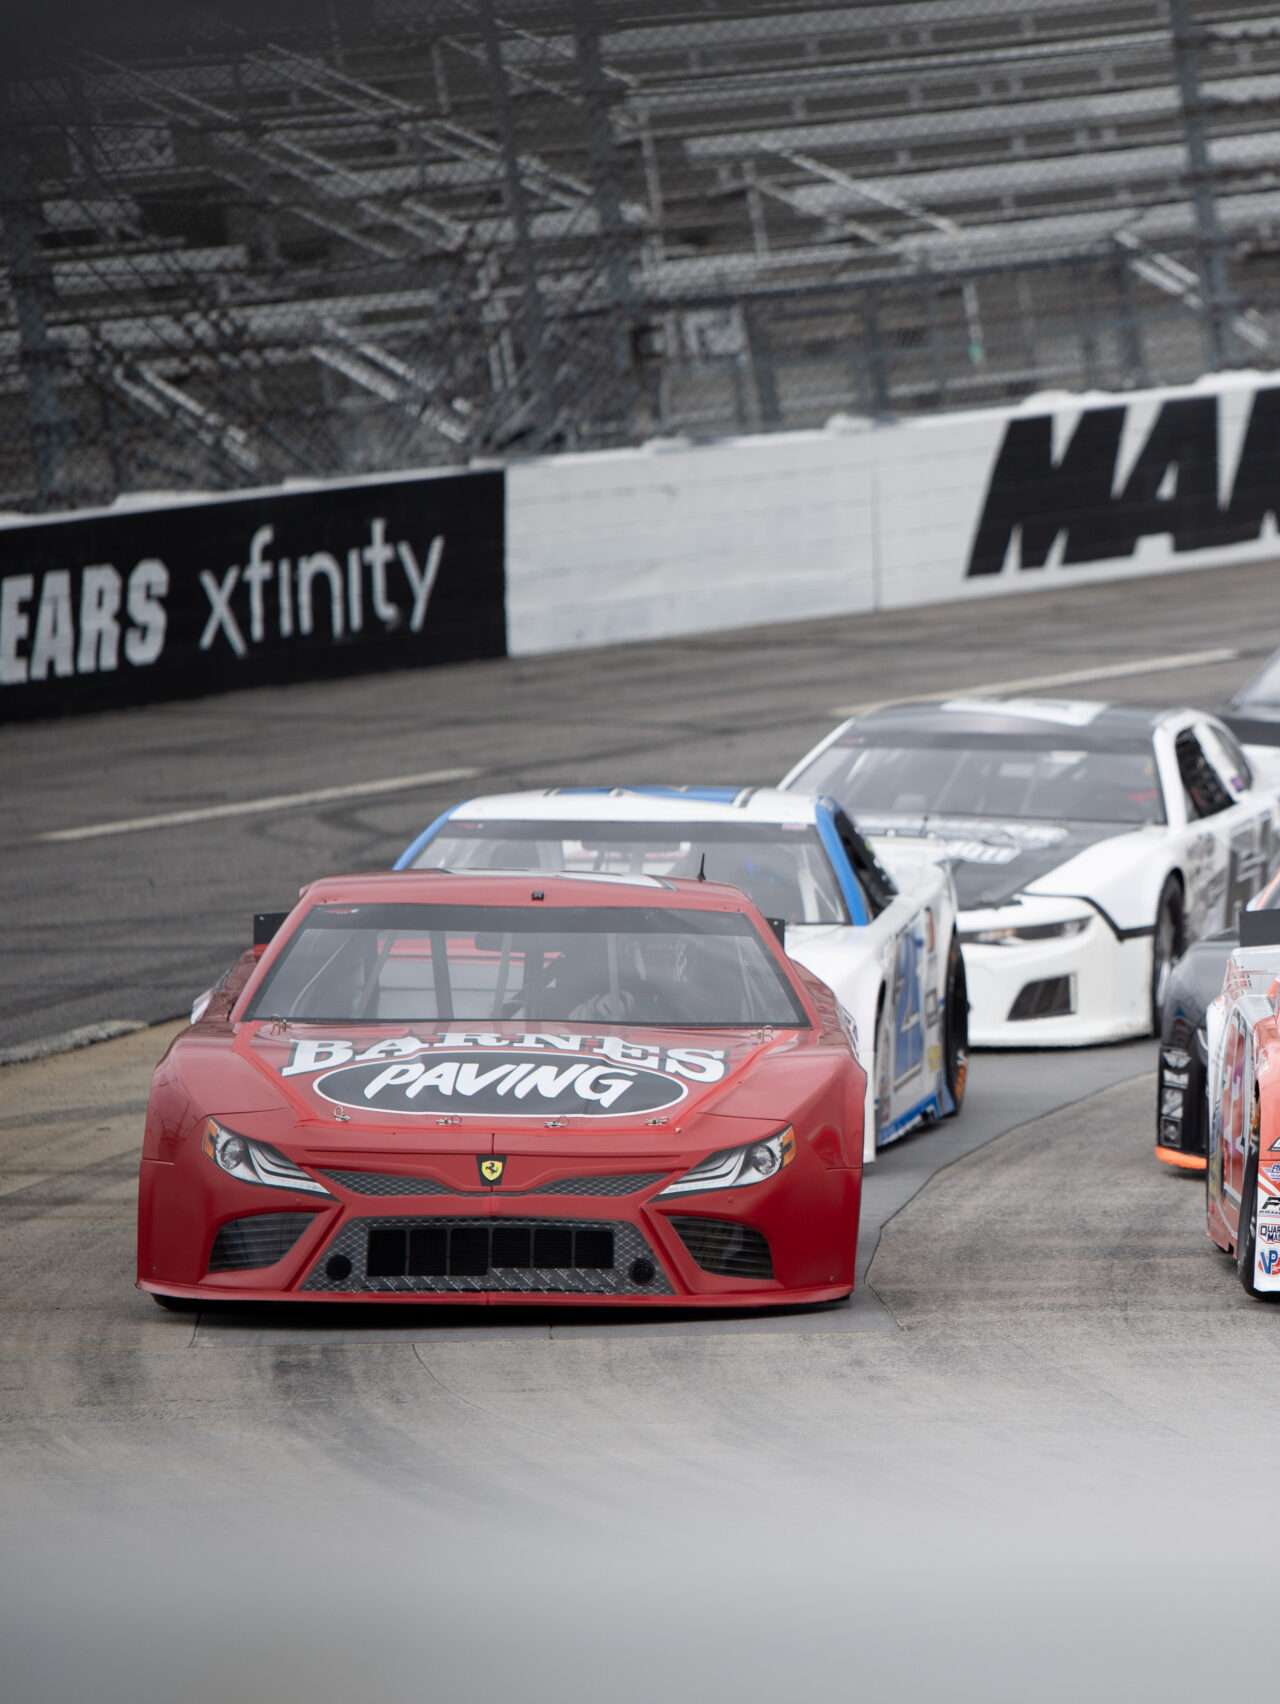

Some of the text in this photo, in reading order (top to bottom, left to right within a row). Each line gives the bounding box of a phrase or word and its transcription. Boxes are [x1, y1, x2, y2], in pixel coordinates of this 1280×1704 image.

[0, 517, 445, 685] EARS xfinity
[281, 1031, 727, 1083] BARNES
[363, 1062, 640, 1108] PAVING
[1260, 1249, 1279, 1275] VP
